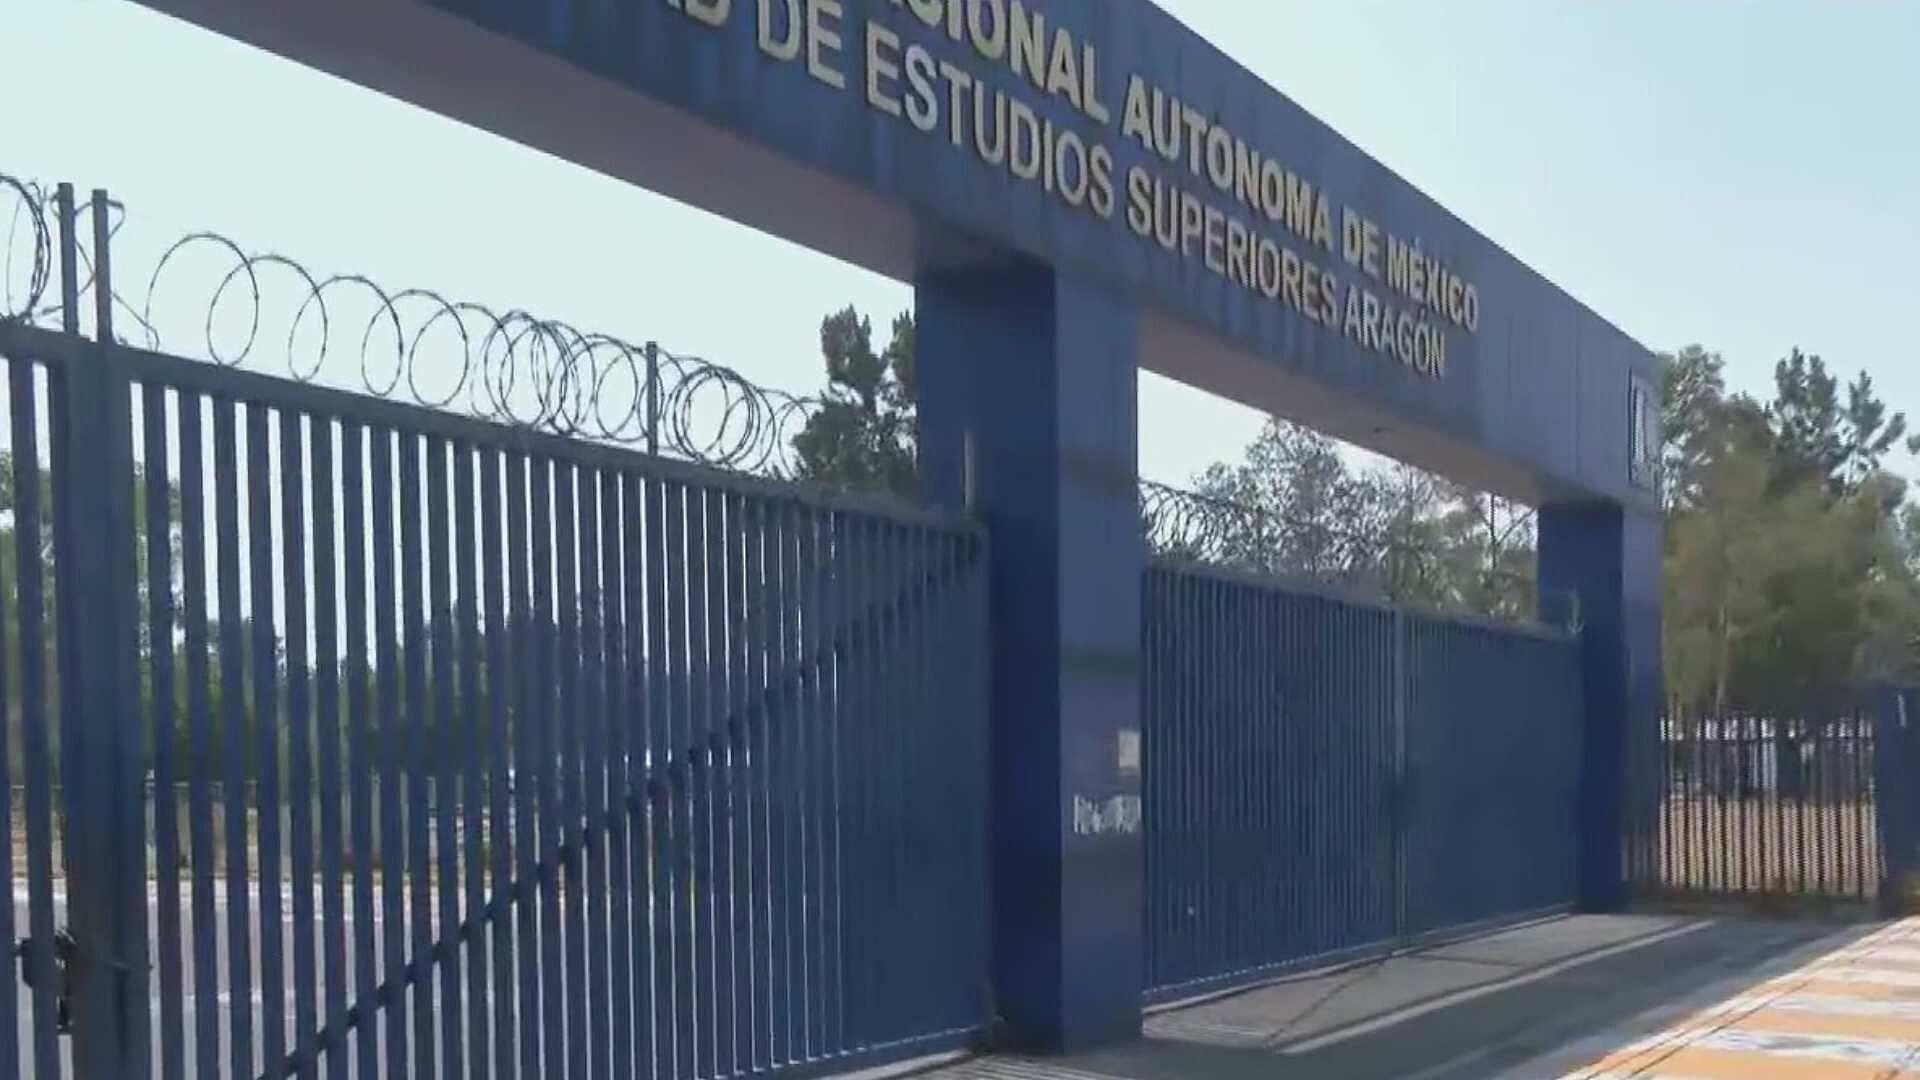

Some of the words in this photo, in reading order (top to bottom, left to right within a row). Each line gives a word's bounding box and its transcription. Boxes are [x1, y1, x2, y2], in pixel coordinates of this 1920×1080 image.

[757, 0, 846, 89] DE
[866, 20, 1115, 219] ESTUDIOS
[1128, 166, 1338, 328] SUPERIORES
[1343, 284, 1446, 378] ARAGÓN
[888, 0, 1110, 124] IONAL
[1343, 204, 1380, 281] DE
[1387, 234, 1479, 333] MÉXICO
